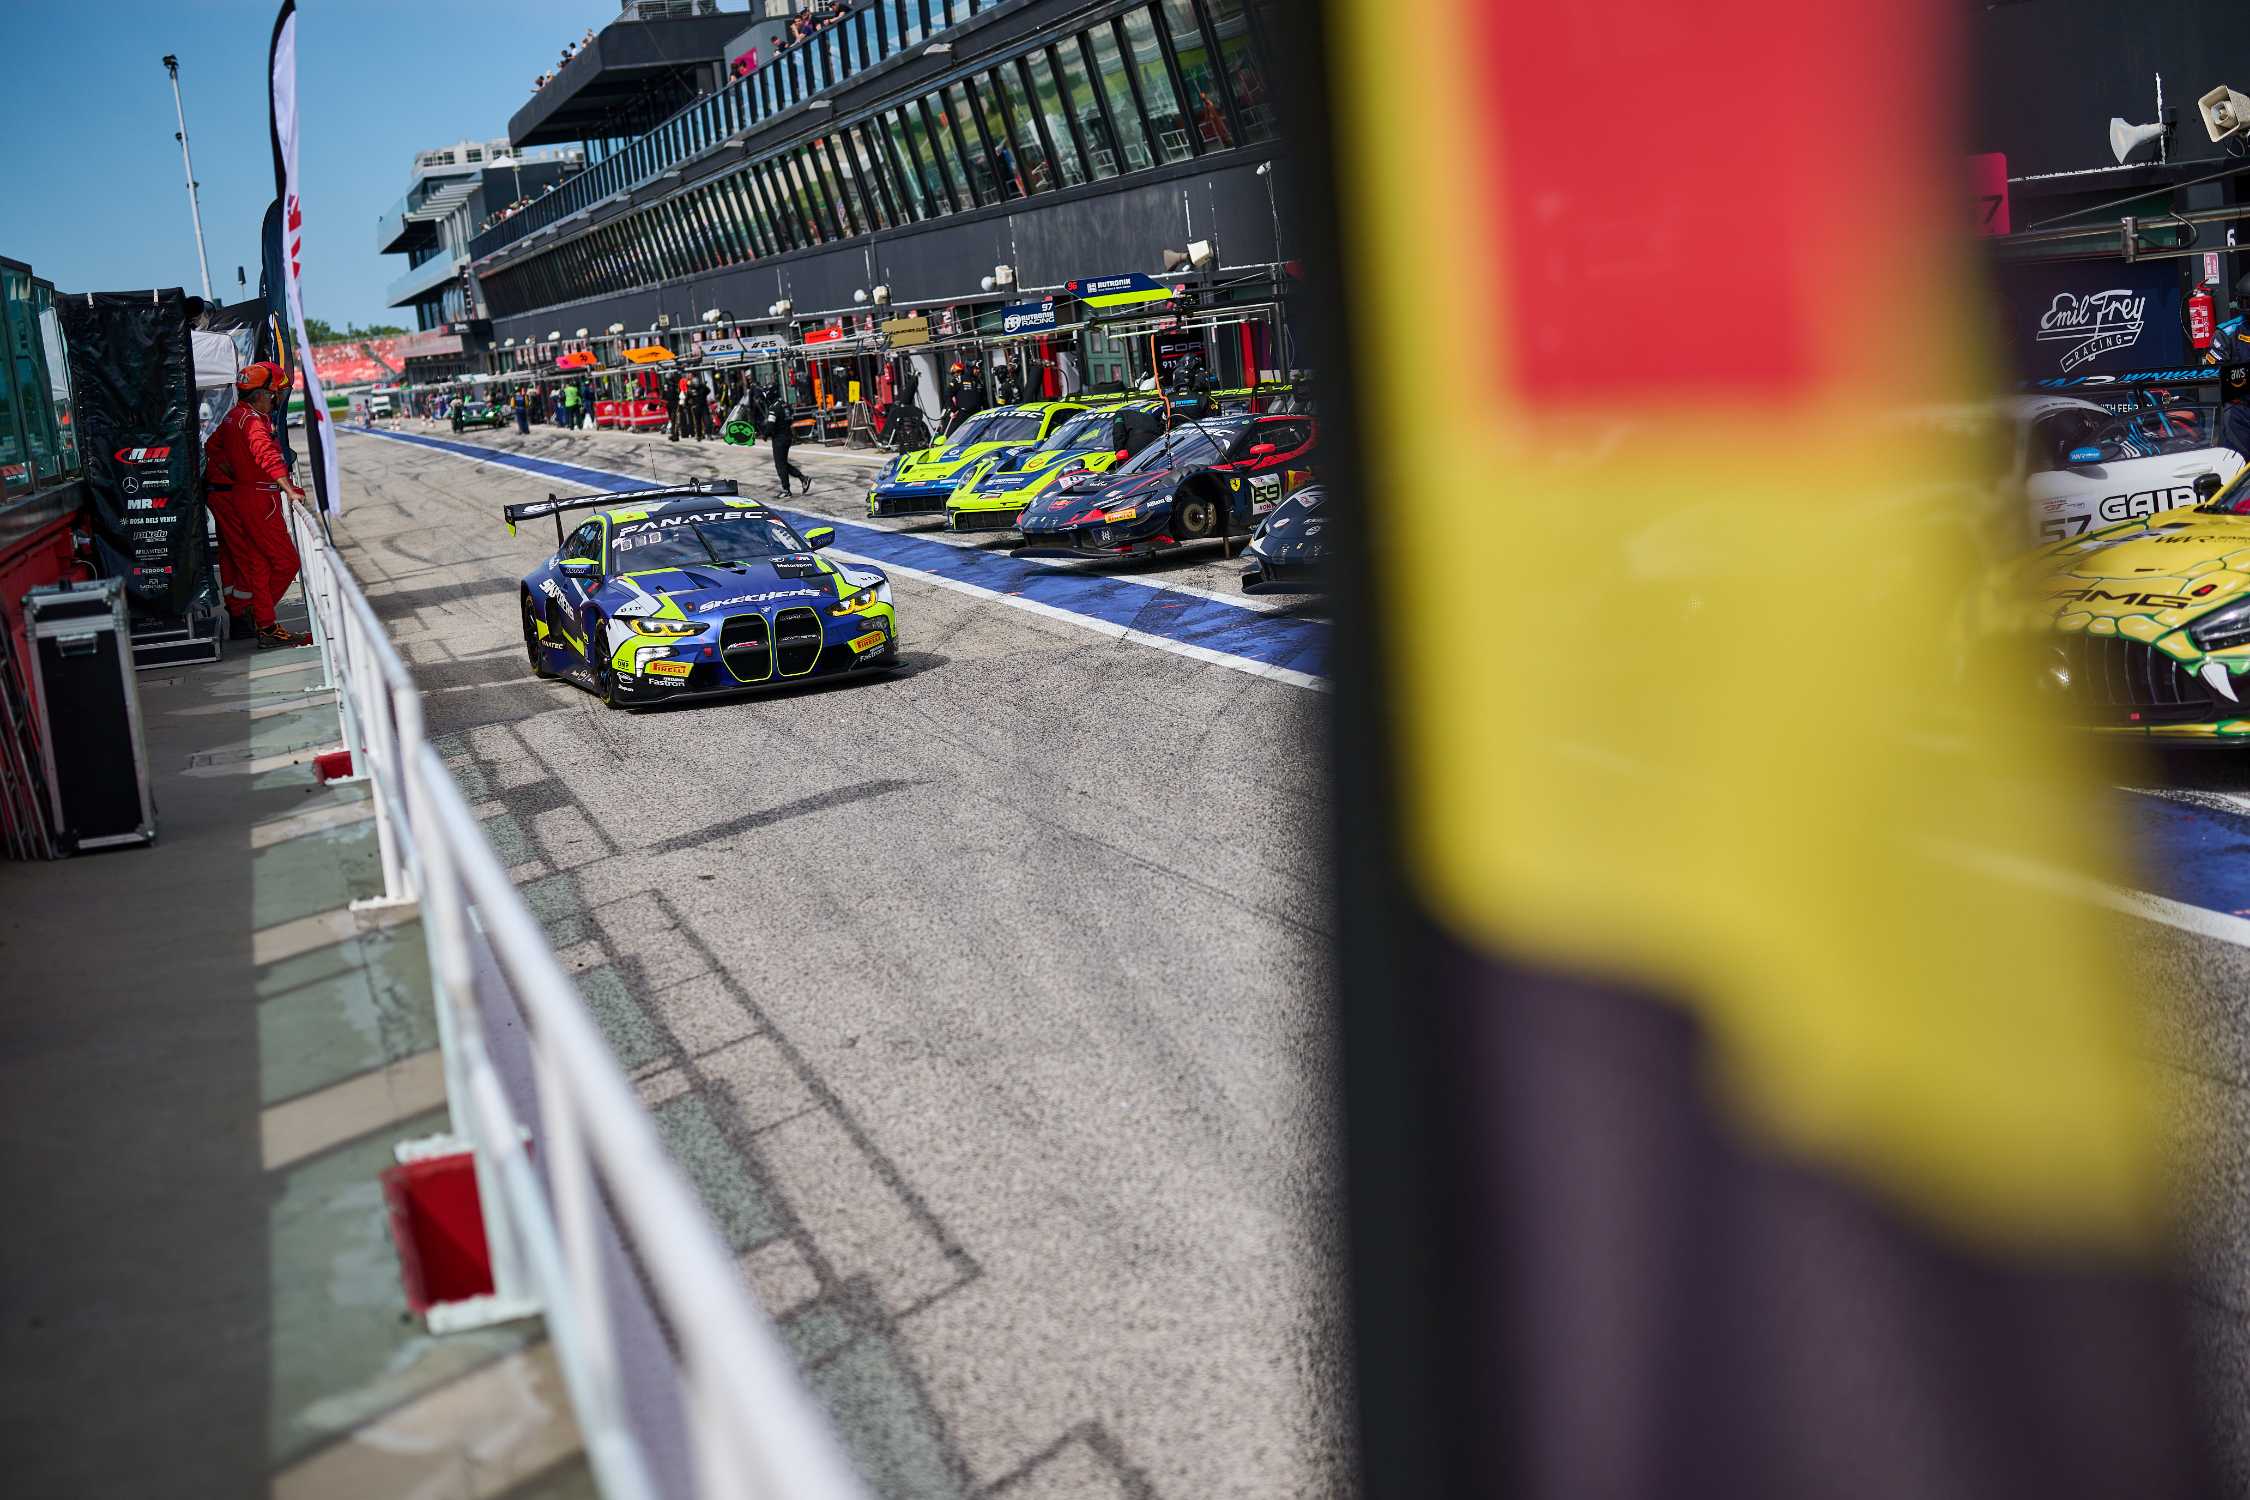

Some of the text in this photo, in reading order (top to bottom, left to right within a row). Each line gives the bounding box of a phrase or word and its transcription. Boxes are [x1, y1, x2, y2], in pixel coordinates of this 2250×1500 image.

[1067, 281, 1077, 291] 96
[1097, 278, 1131, 289] RUTRONIK
[1041, 303, 1053, 312] 97
[2041, 293, 2090, 329] Emil
[2090, 289, 2146, 338] Frey
[1021, 318, 1055, 326] RACING
[751, 340, 777, 349] #25
[2074, 335, 2122, 361] RACING
[128, 496, 169, 510] MRW
[619, 511, 768, 537] FANATEC
[699, 589, 820, 613] SKECHERS
[2053, 589, 2192, 609] AMG
[653, 662, 686, 674] PIRELLI
[648, 678, 685, 687] Fastron
